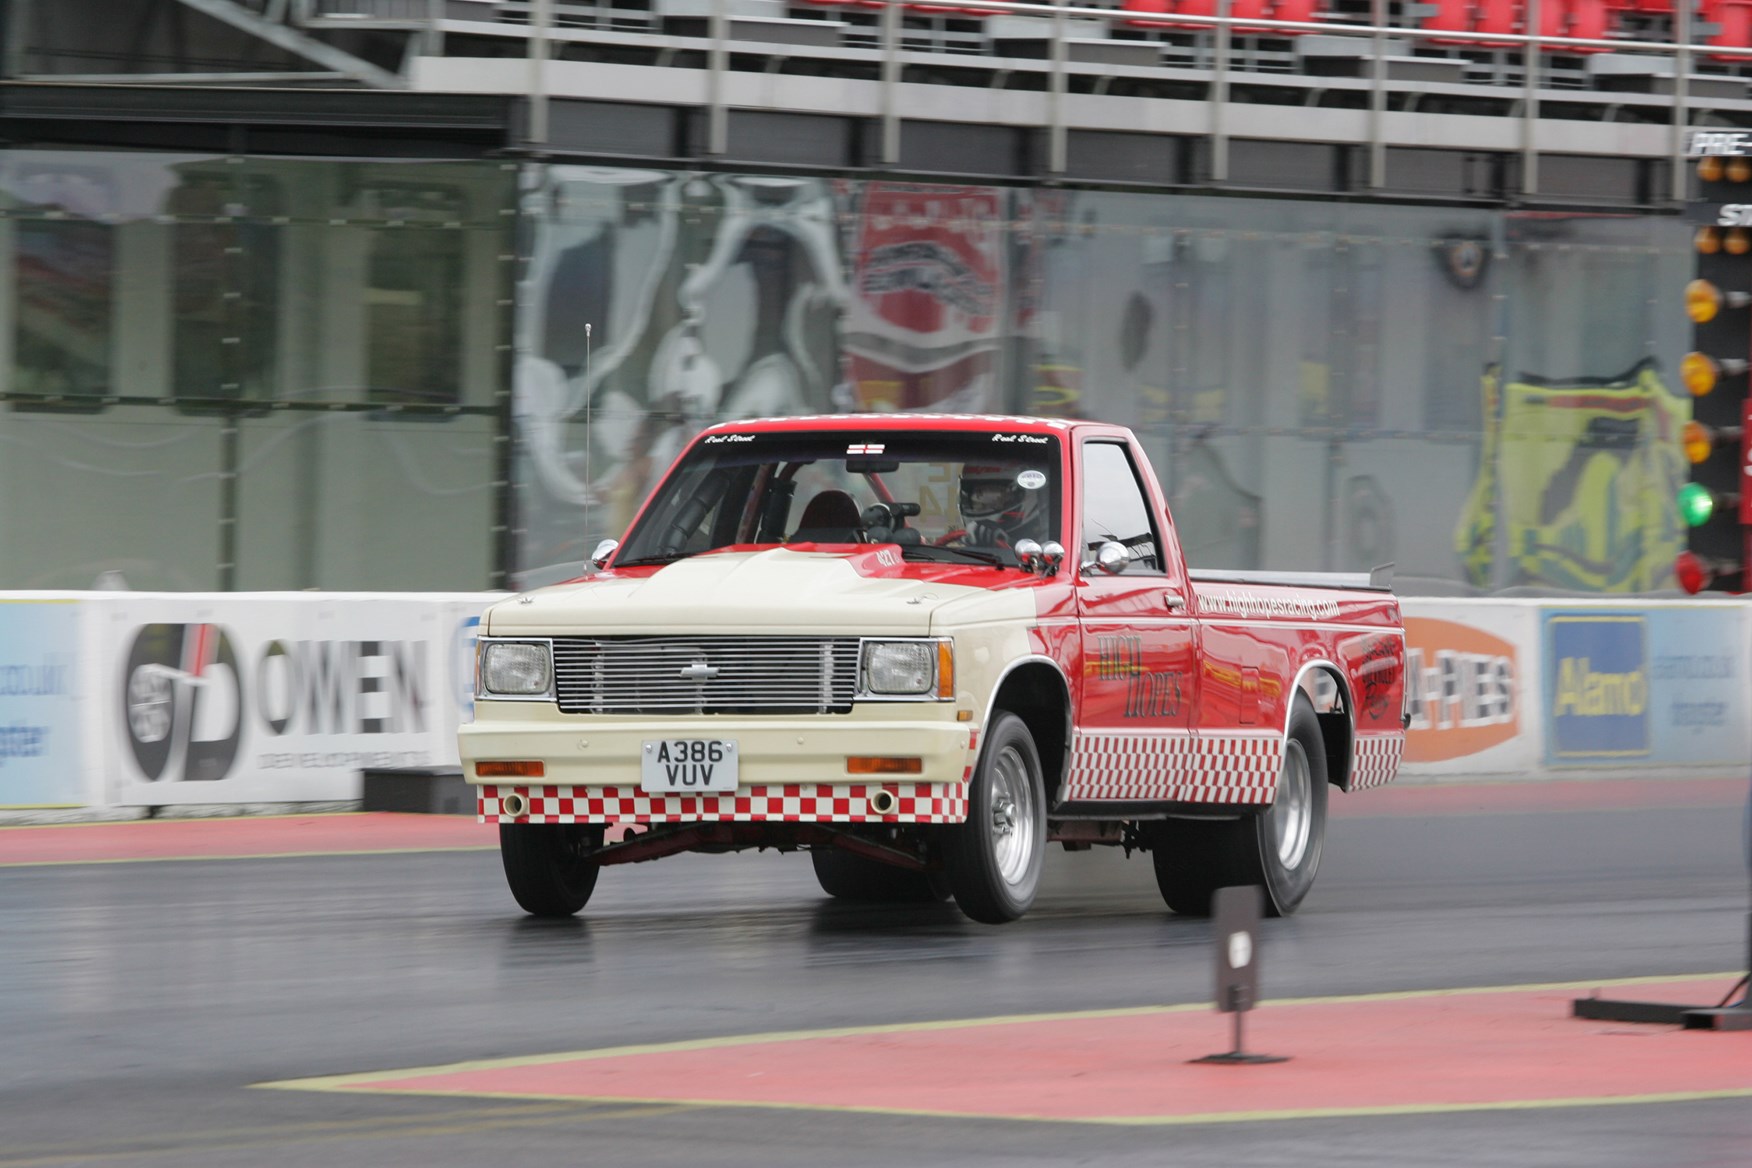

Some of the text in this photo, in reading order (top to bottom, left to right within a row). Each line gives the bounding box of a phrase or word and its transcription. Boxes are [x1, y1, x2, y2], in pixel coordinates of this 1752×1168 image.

[1197, 590, 1340, 621] www.highhopesracing.com
[257, 639, 429, 736] OWEN
[1124, 671, 1183, 718] HOPES
[657, 740, 723, 763] A386
[665, 763, 714, 786] VUV
